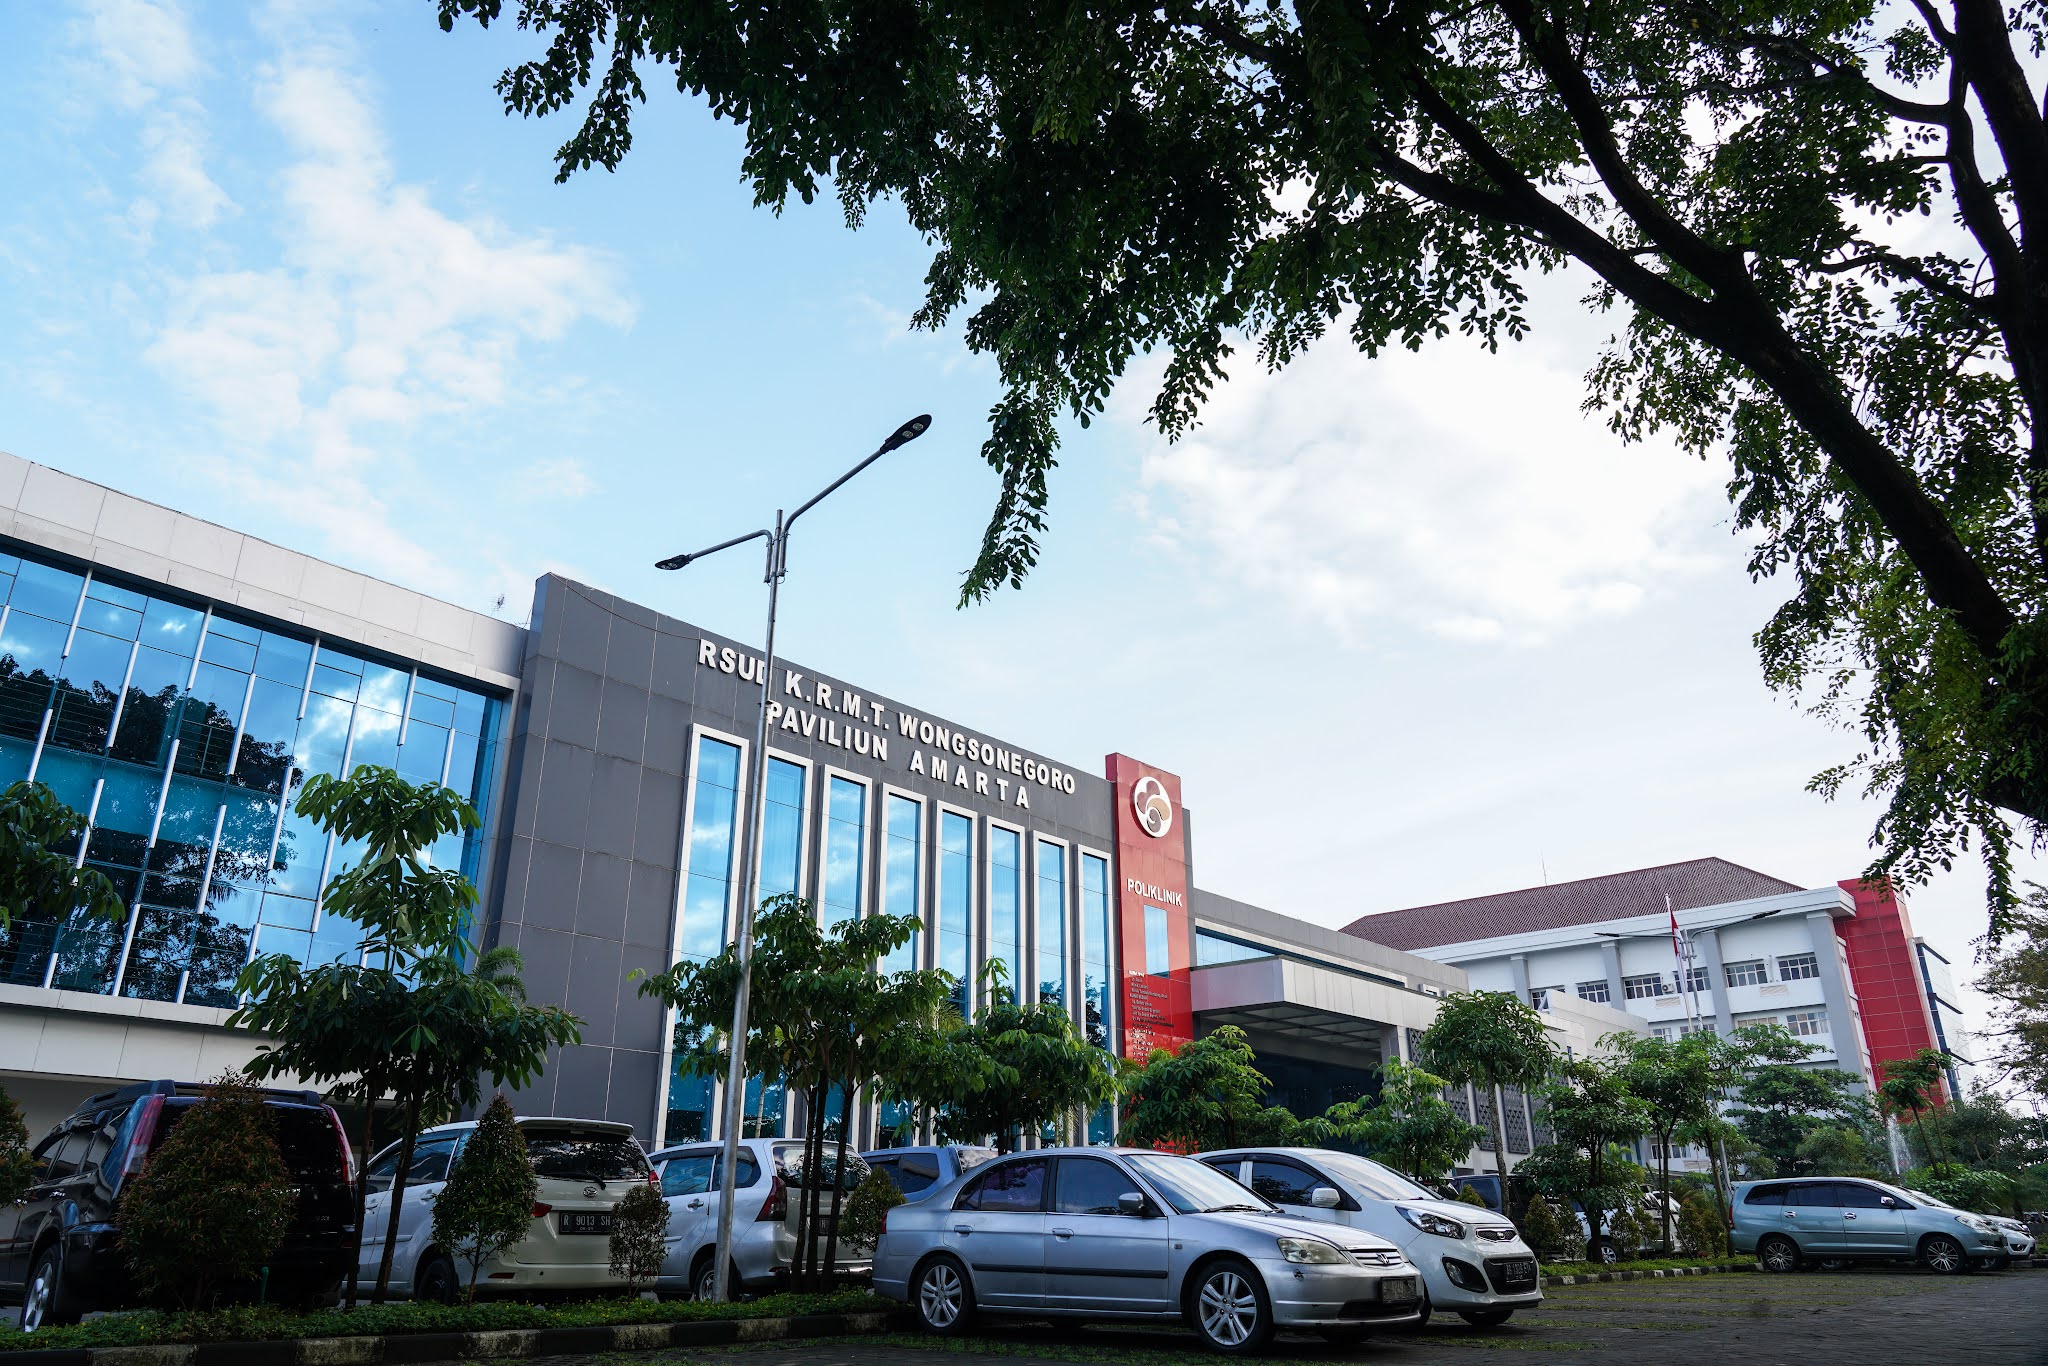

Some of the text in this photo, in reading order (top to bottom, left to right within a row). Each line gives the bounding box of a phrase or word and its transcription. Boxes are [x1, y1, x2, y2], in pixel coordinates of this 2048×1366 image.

[766, 699, 1029, 809] PAVILIUN AMARTA
[785, 669, 890, 730] K.R.M.T.
[898, 711, 1076, 795] WONGSONEGORO
[1127, 877, 1183, 908] POLIKLINIK
[575, 1215, 595, 1226] 9013
